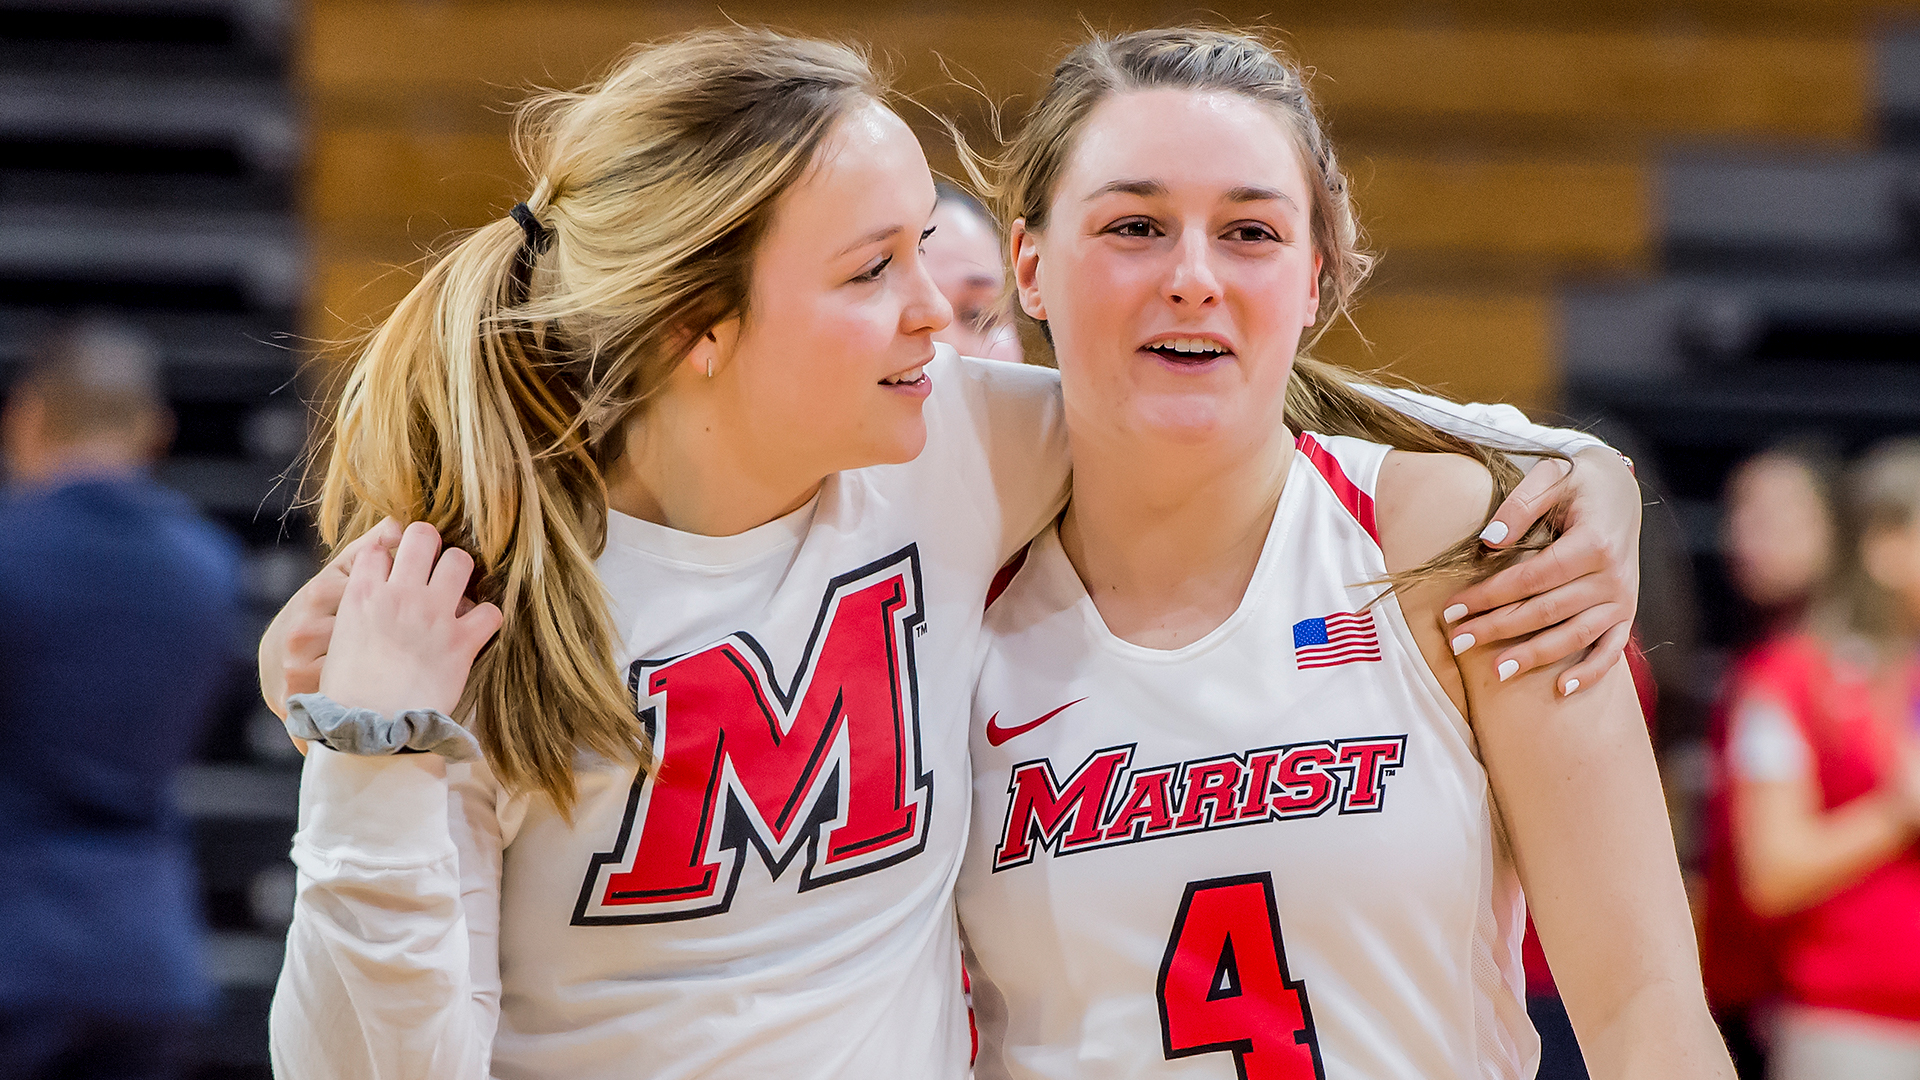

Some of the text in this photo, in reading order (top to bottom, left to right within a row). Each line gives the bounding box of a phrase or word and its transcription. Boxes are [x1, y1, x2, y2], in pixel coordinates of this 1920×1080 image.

[570, 542, 934, 926] M
[992, 734, 1408, 874] MARIST
[1156, 871, 1326, 1080] 4
